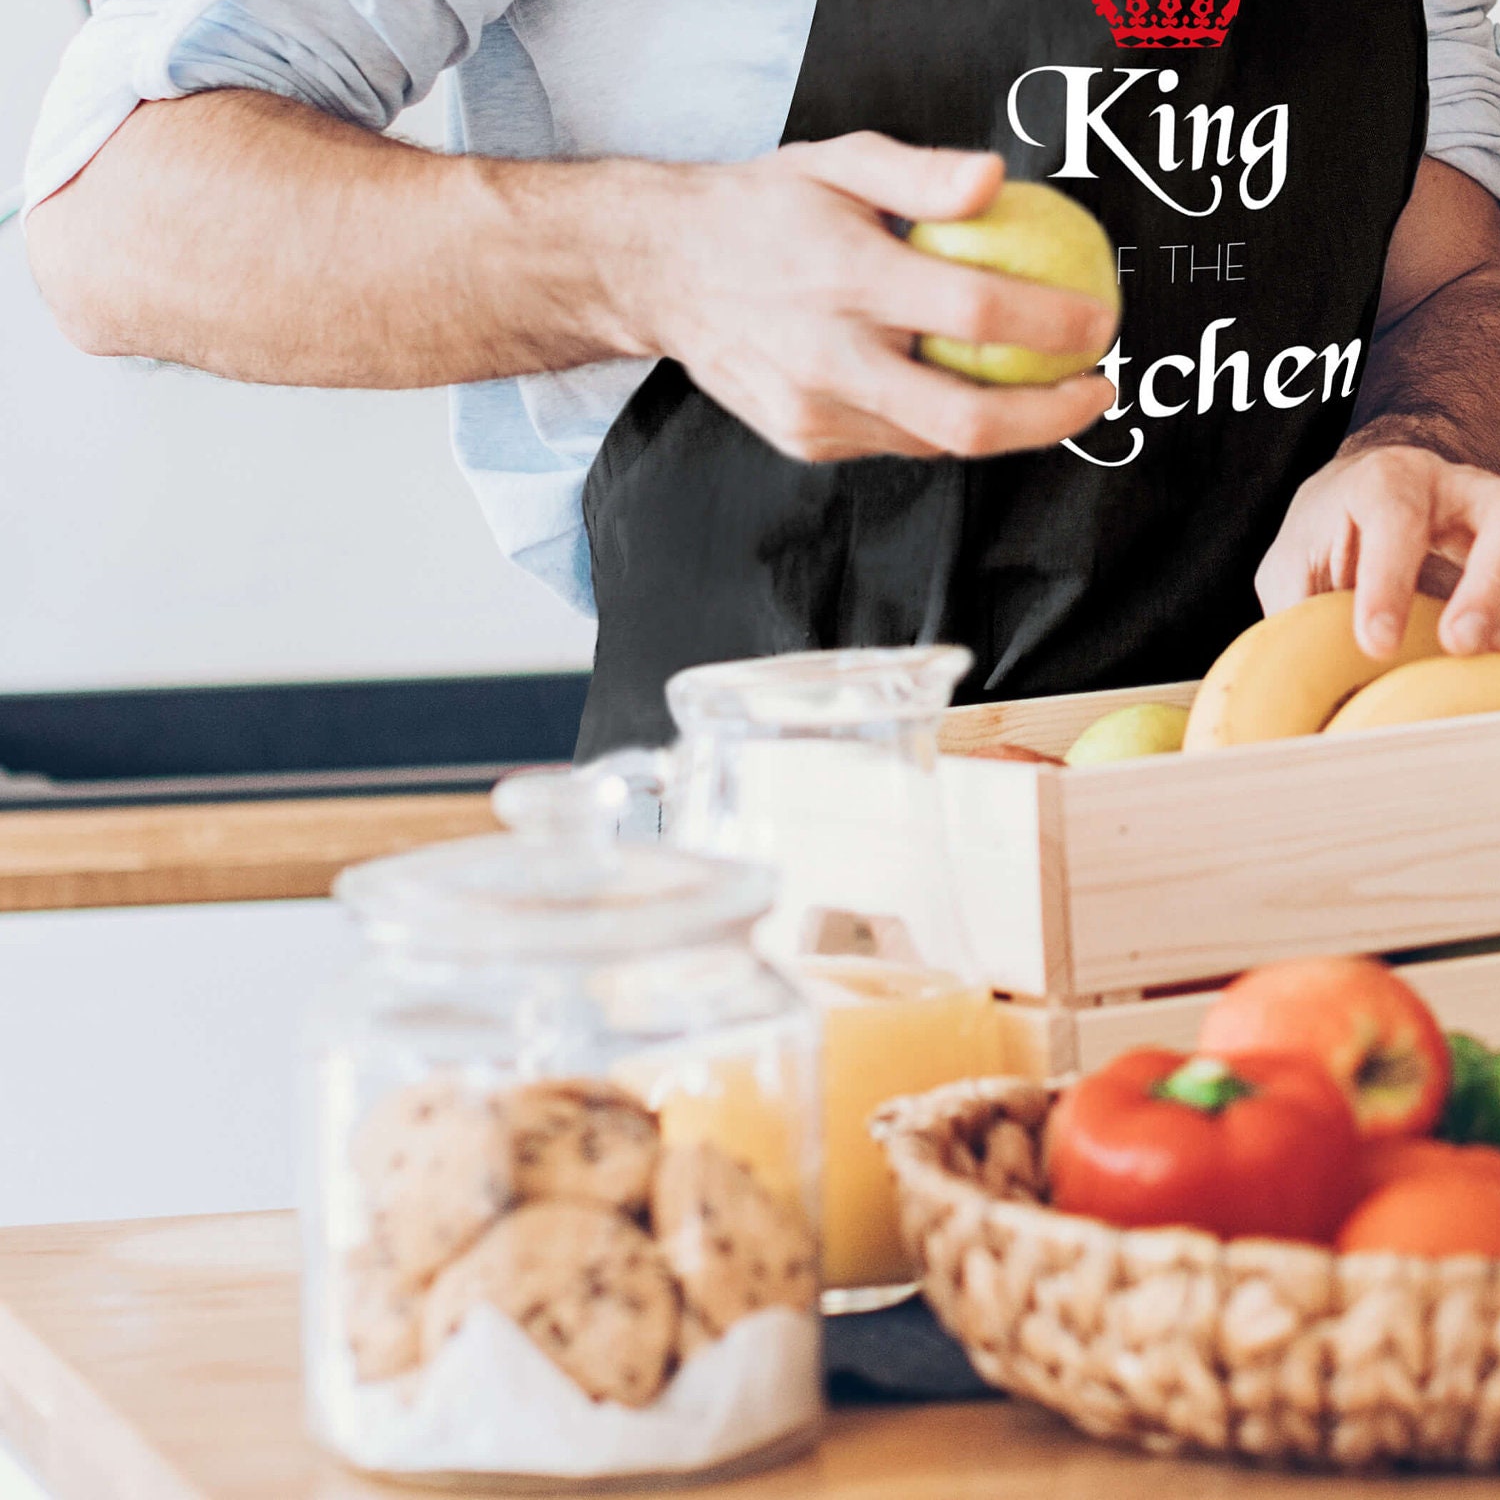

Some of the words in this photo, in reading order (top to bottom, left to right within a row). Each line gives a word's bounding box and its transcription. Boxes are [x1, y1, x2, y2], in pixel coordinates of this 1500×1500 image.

[1007, 65, 1289, 217] King
[1117, 246, 1138, 285] F
[1159, 242, 1246, 284] THE
[1060, 317, 1362, 467] tchen
